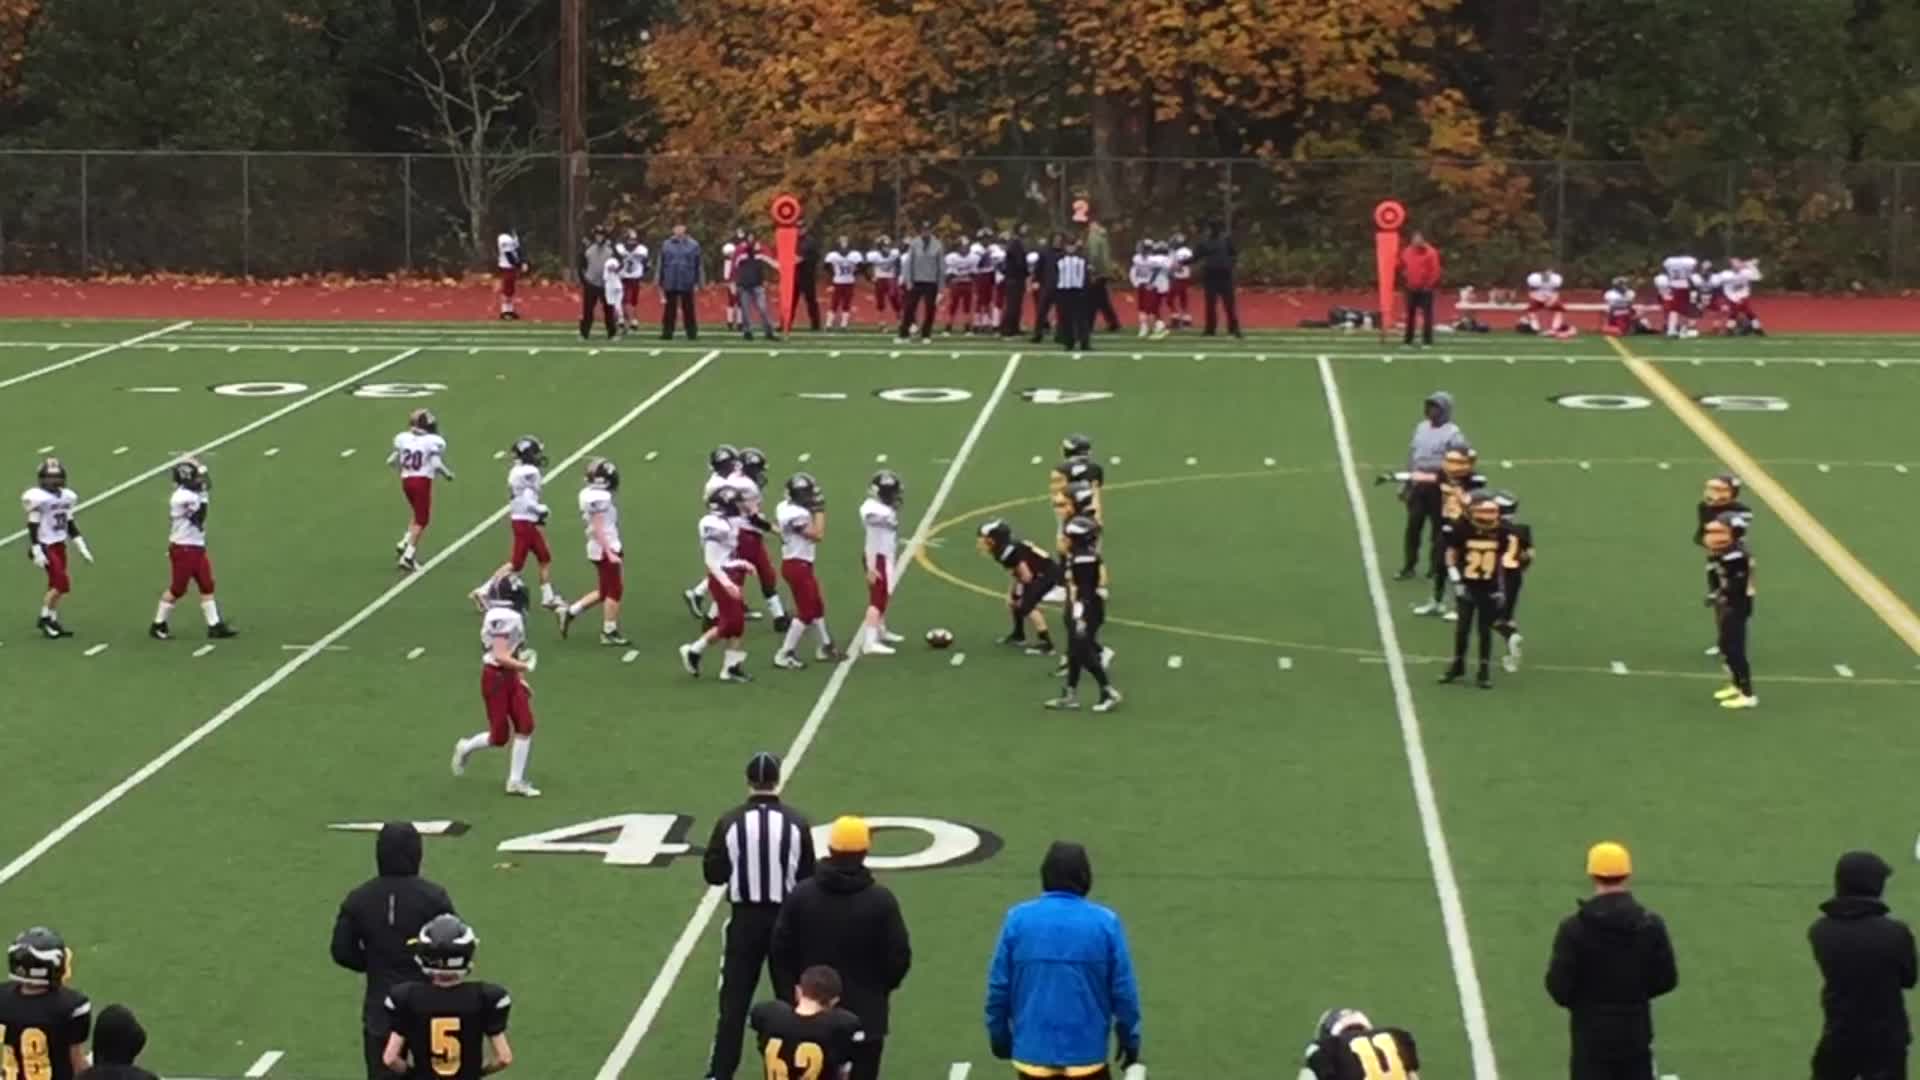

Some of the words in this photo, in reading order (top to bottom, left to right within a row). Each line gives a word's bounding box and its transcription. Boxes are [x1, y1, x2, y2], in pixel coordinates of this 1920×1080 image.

[402, 449, 423, 471] 20
[1464, 551, 1494, 579] 29
[430, 1016, 462, 1077] 5
[764, 1038, 824, 1080] 62
